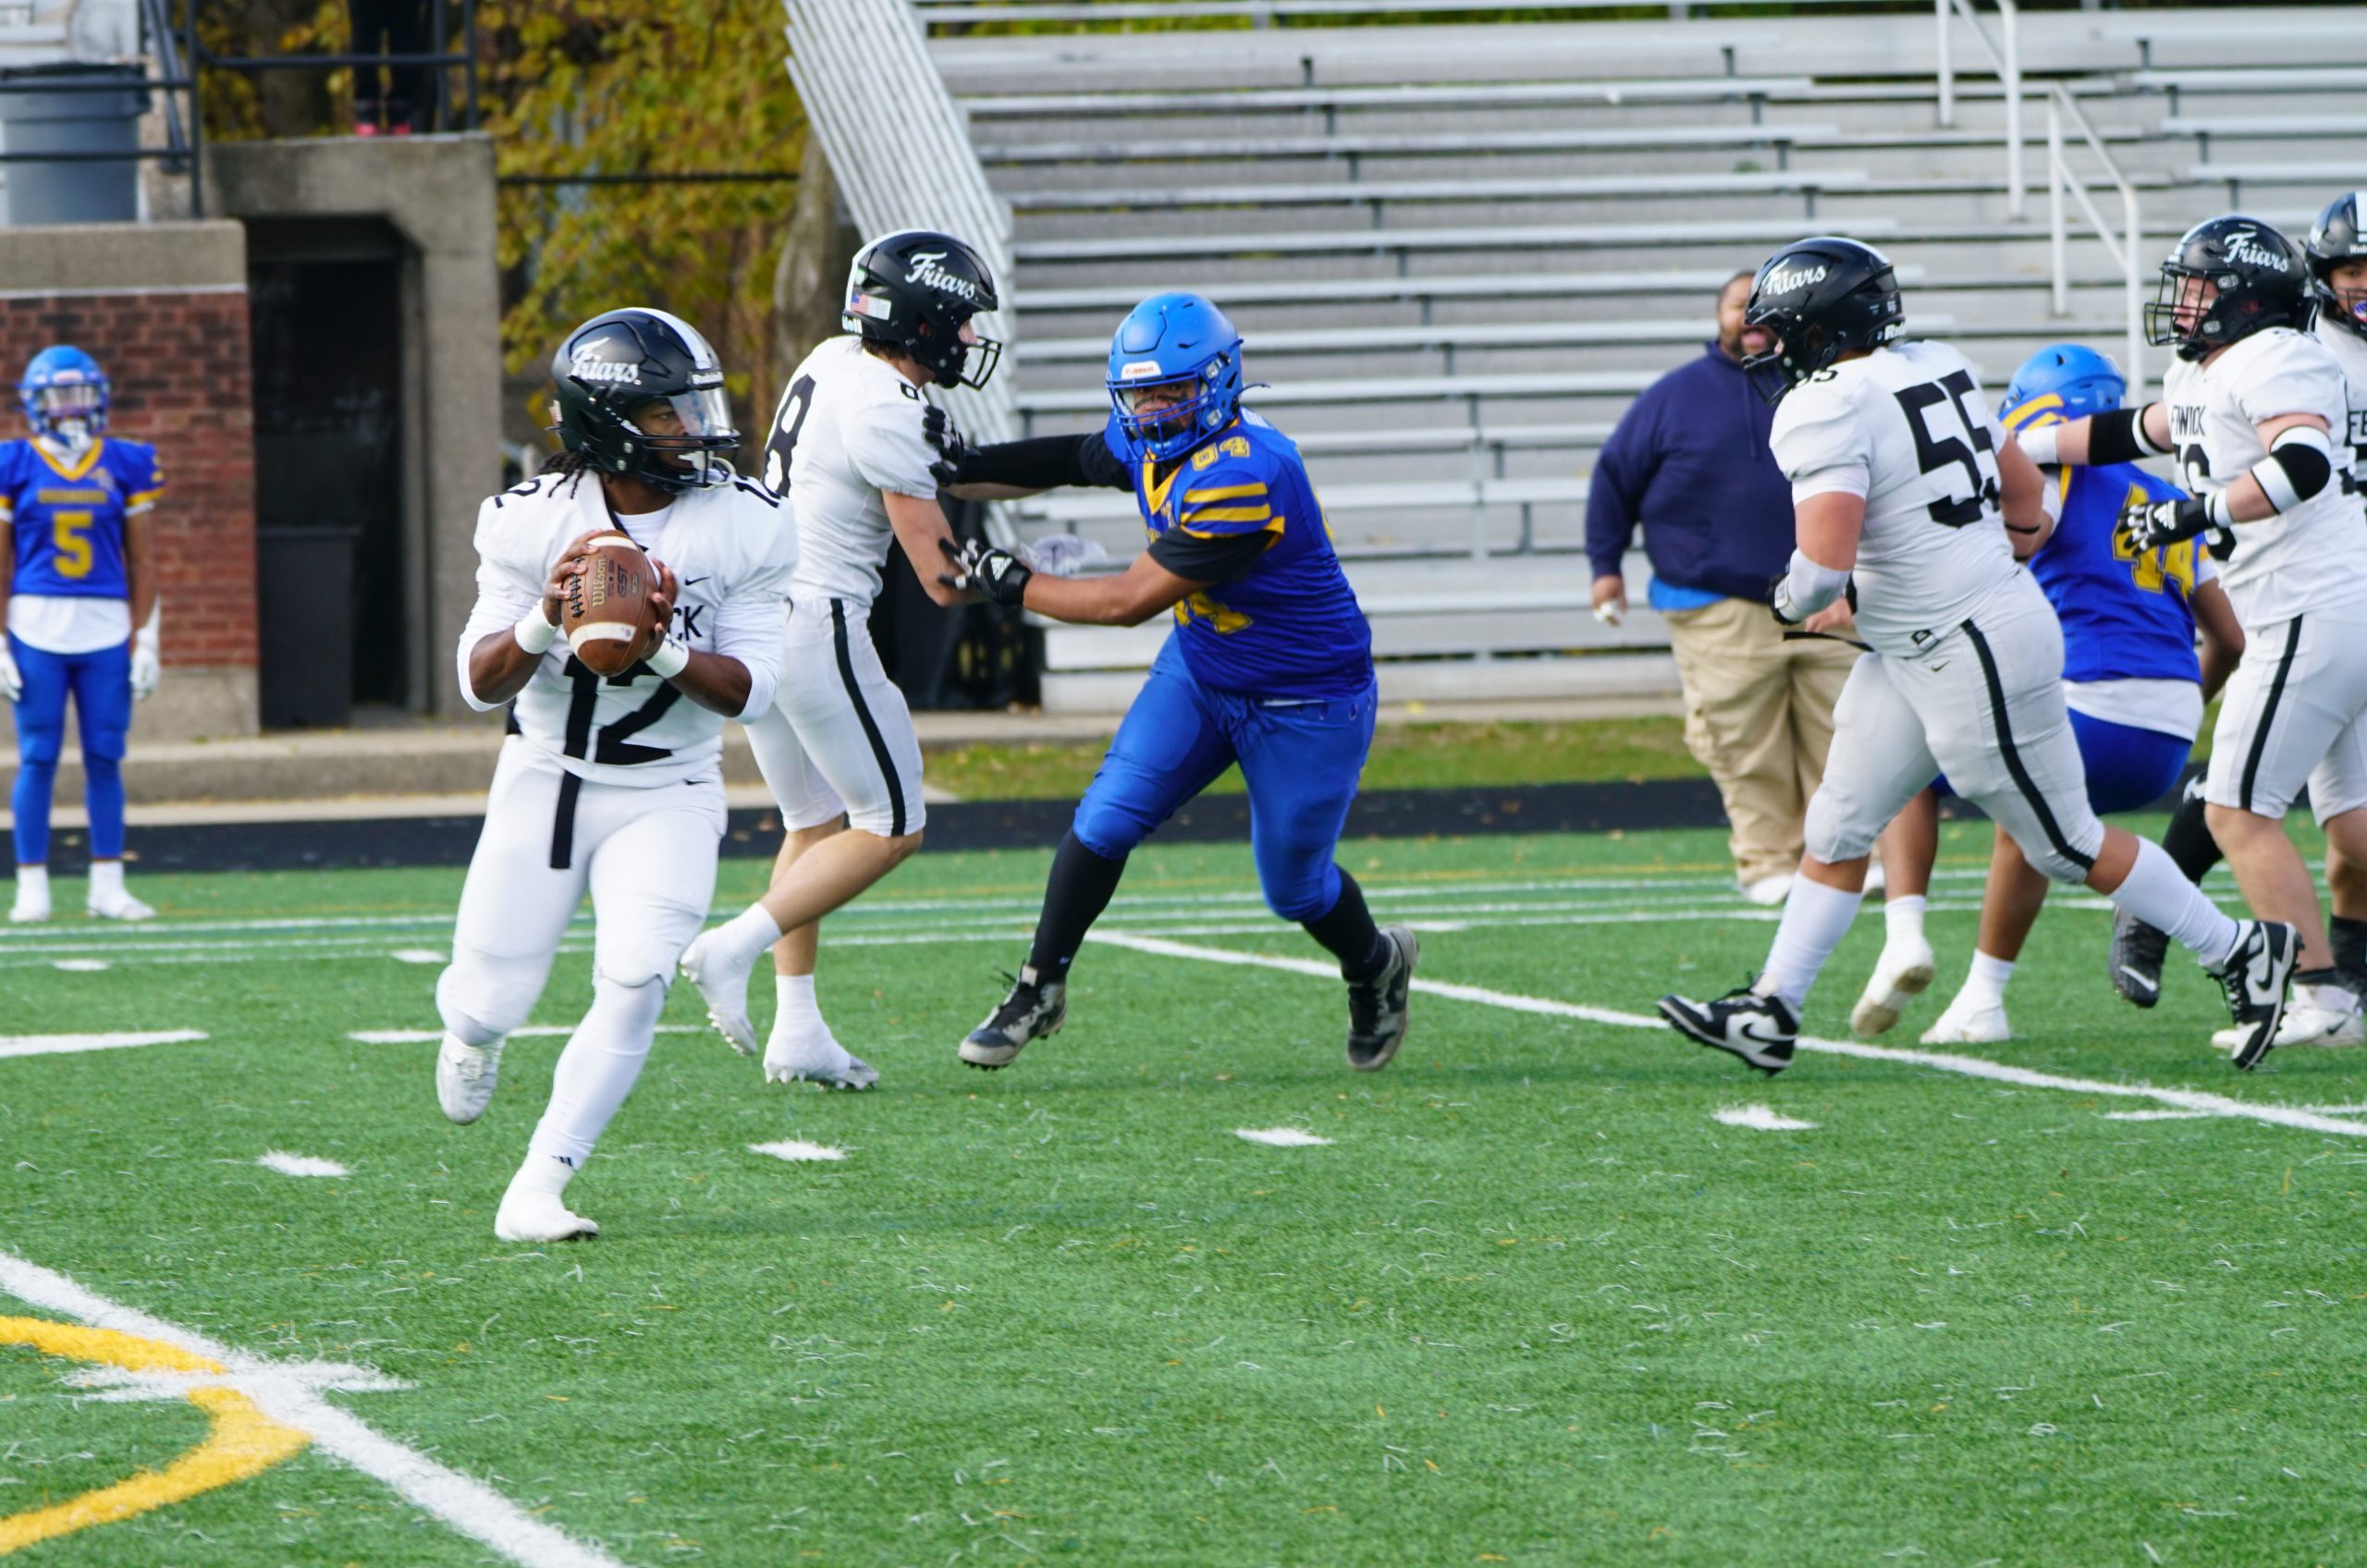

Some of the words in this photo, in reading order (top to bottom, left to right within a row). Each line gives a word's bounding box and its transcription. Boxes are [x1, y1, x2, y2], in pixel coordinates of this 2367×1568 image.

[905, 251, 975, 299] Friars
[1762, 259, 1827, 296] Friars
[2224, 231, 2289, 274] Friars
[566, 337, 640, 383] Friars
[760, 373, 816, 498] 8
[1892, 368, 2001, 529] 55
[54, 510, 92, 580] 5
[592, 557, 607, 607] Wilson
[563, 653, 683, 766] 12
